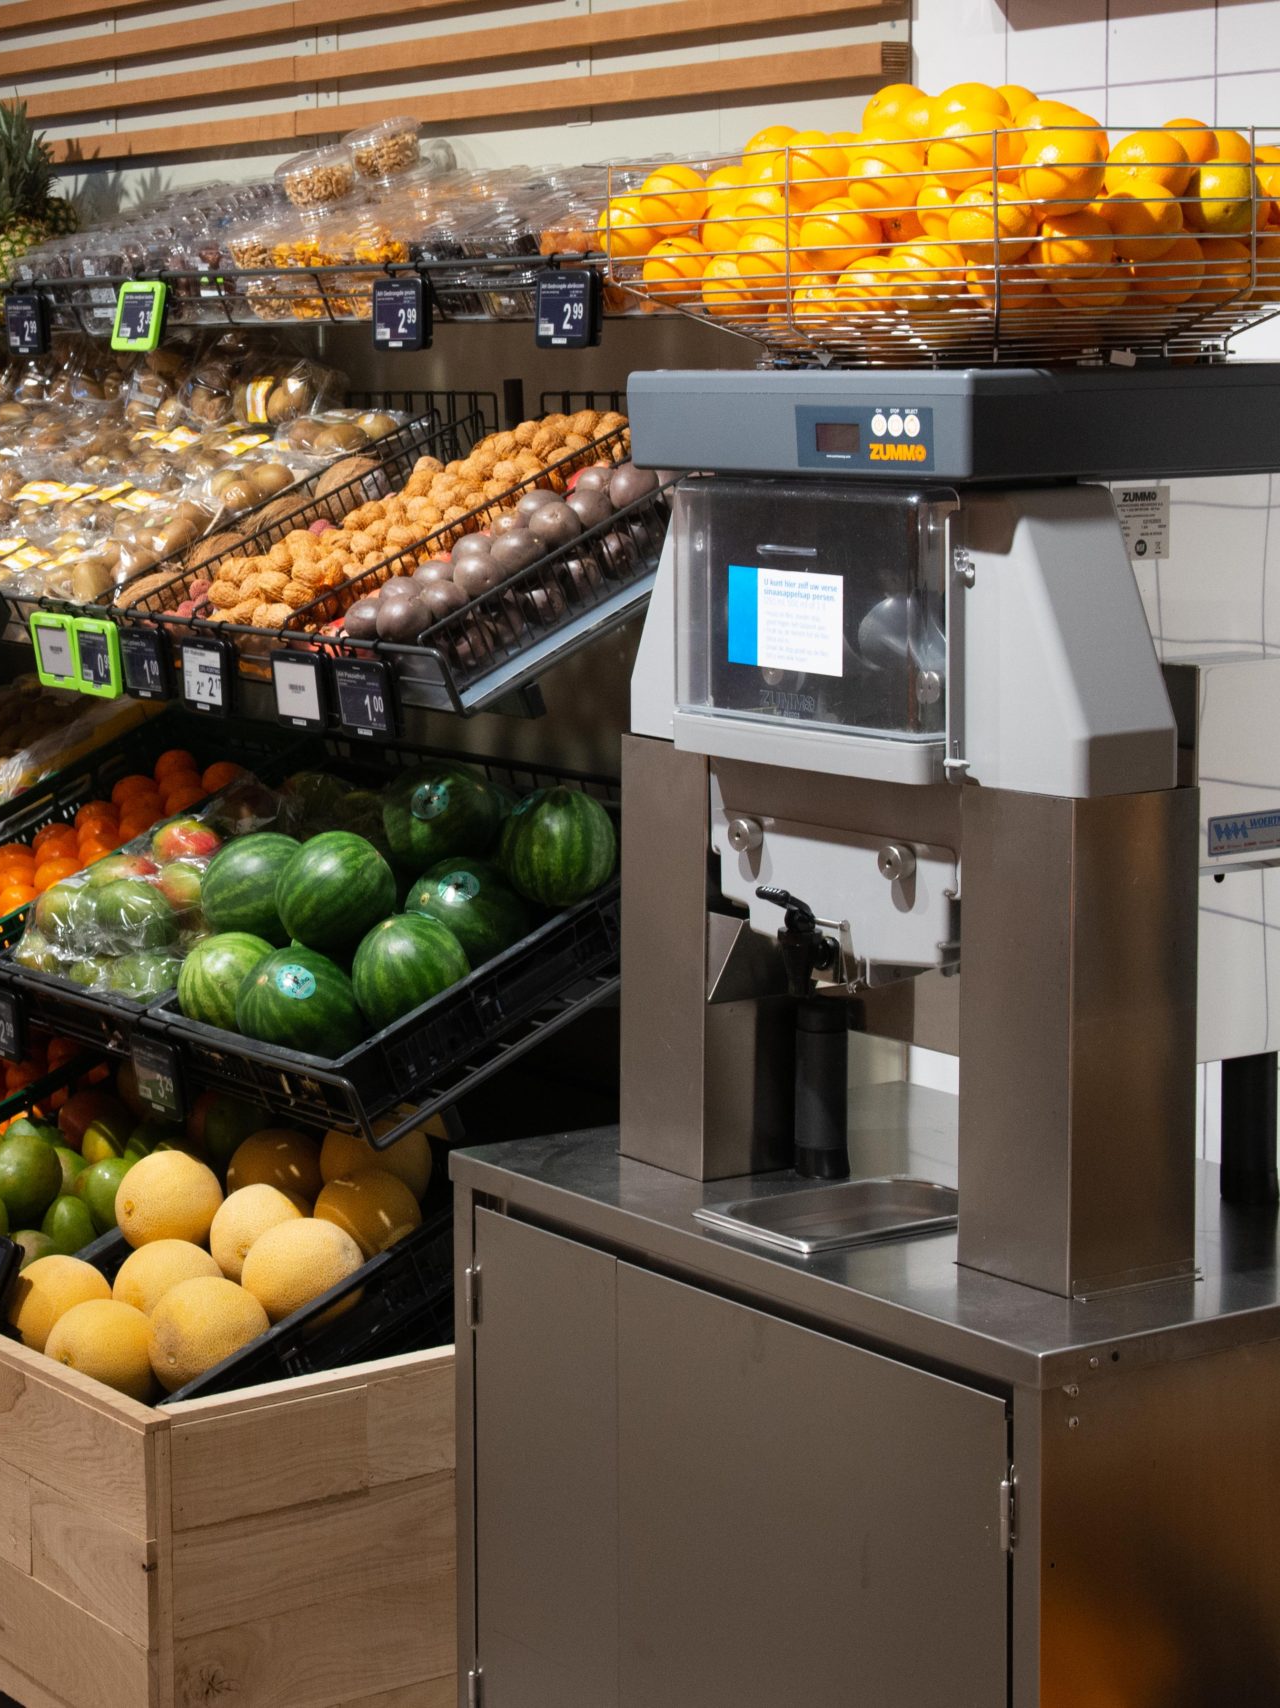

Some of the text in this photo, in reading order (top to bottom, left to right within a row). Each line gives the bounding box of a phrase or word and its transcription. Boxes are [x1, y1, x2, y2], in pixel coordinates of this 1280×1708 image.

[398, 308, 416, 334] 2.99
[562, 302, 583, 330] 2.99
[23, 320, 37, 342] 2.99
[869, 443, 927, 462] ZUMMO
[1122, 491, 1157, 502] ZUMMO
[785, 579, 796, 588] hier
[144, 660, 159, 685] 1.00
[364, 693, 384, 722] 1.00
